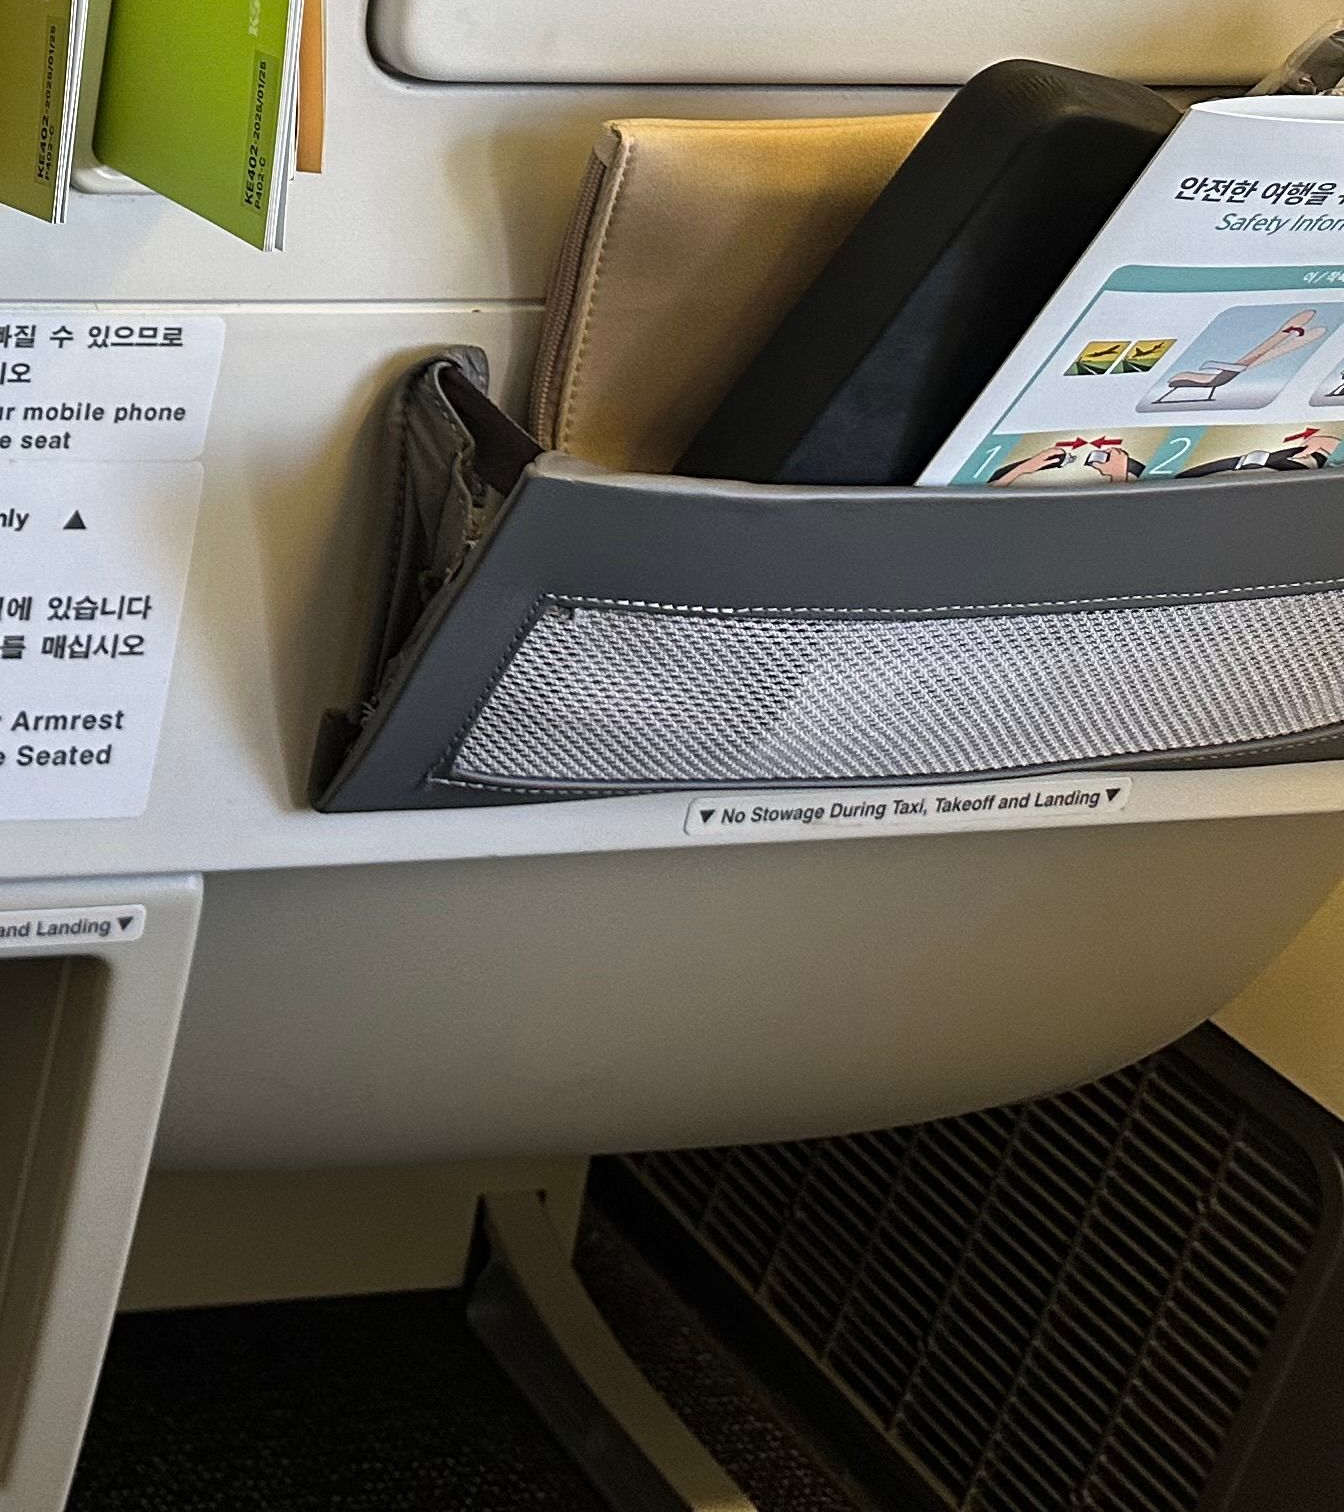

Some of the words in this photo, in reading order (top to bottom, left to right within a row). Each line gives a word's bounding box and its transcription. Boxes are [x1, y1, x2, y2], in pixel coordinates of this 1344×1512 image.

[254, 157, 266, 209] P402-C
[1174, 177, 1260, 204] 안전한
[1261, 181, 1337, 206] 여행을
[1215, 213, 1291, 236] Safety
[49, 325, 74, 348] 수
[87, 325, 184, 349] 있으므로
[23, 403, 105, 422] mobile
[114, 404, 186, 425] phone
[20, 432, 71, 449] seat
[973, 445, 1002, 478] 1
[1149, 437, 1191, 475] 2
[47, 595, 152, 621] 있습니다
[41, 635, 145, 659] 매십시오
[11, 710, 125, 732] Armrest
[16, 745, 112, 766] Seated
[721, 808, 746, 825] No
[751, 806, 824, 824] Stowage
[830, 802, 887, 819] During
[892, 799, 928, 816] Taxi,
[935, 795, 996, 812] Takeoff
[998, 793, 1030, 809] and
[1034, 790, 1101, 809] Landing
[36, 917, 112, 938] Landing
